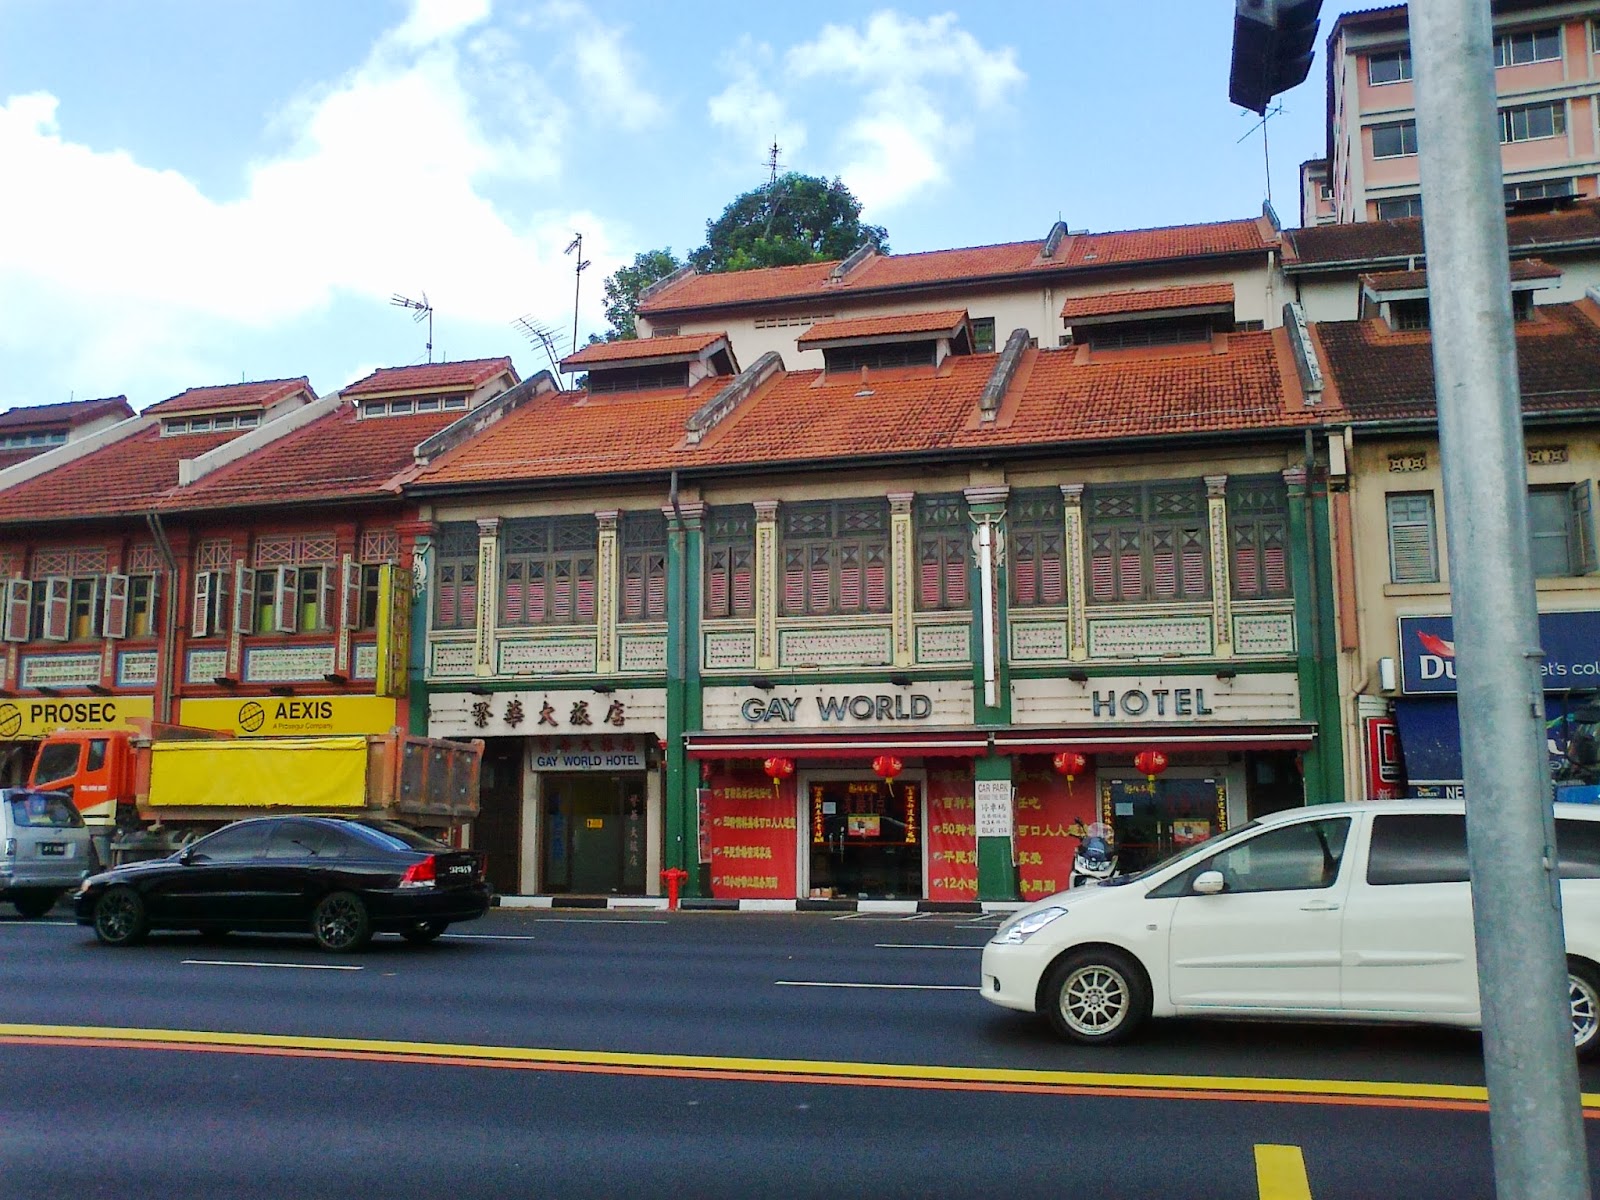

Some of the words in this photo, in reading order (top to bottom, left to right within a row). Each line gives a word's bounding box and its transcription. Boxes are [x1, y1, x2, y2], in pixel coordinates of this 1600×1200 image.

[1419, 655, 1457, 680] Du
[1540, 662, 1568, 676] et's
[275, 701, 333, 719] AEXIS
[741, 697, 802, 722] GAY
[816, 694, 932, 722] WORLD
[1091, 688, 1213, 718] HOTEL
[31, 703, 116, 723] PROSEC
[305, 722, 333, 730] Company
[537, 756, 559, 767] GAY
[564, 755, 602, 767] WORLD
[606, 755, 639, 766] HOTEL
[978, 784, 991, 793] CAR
[992, 784, 1008, 793] PARK
